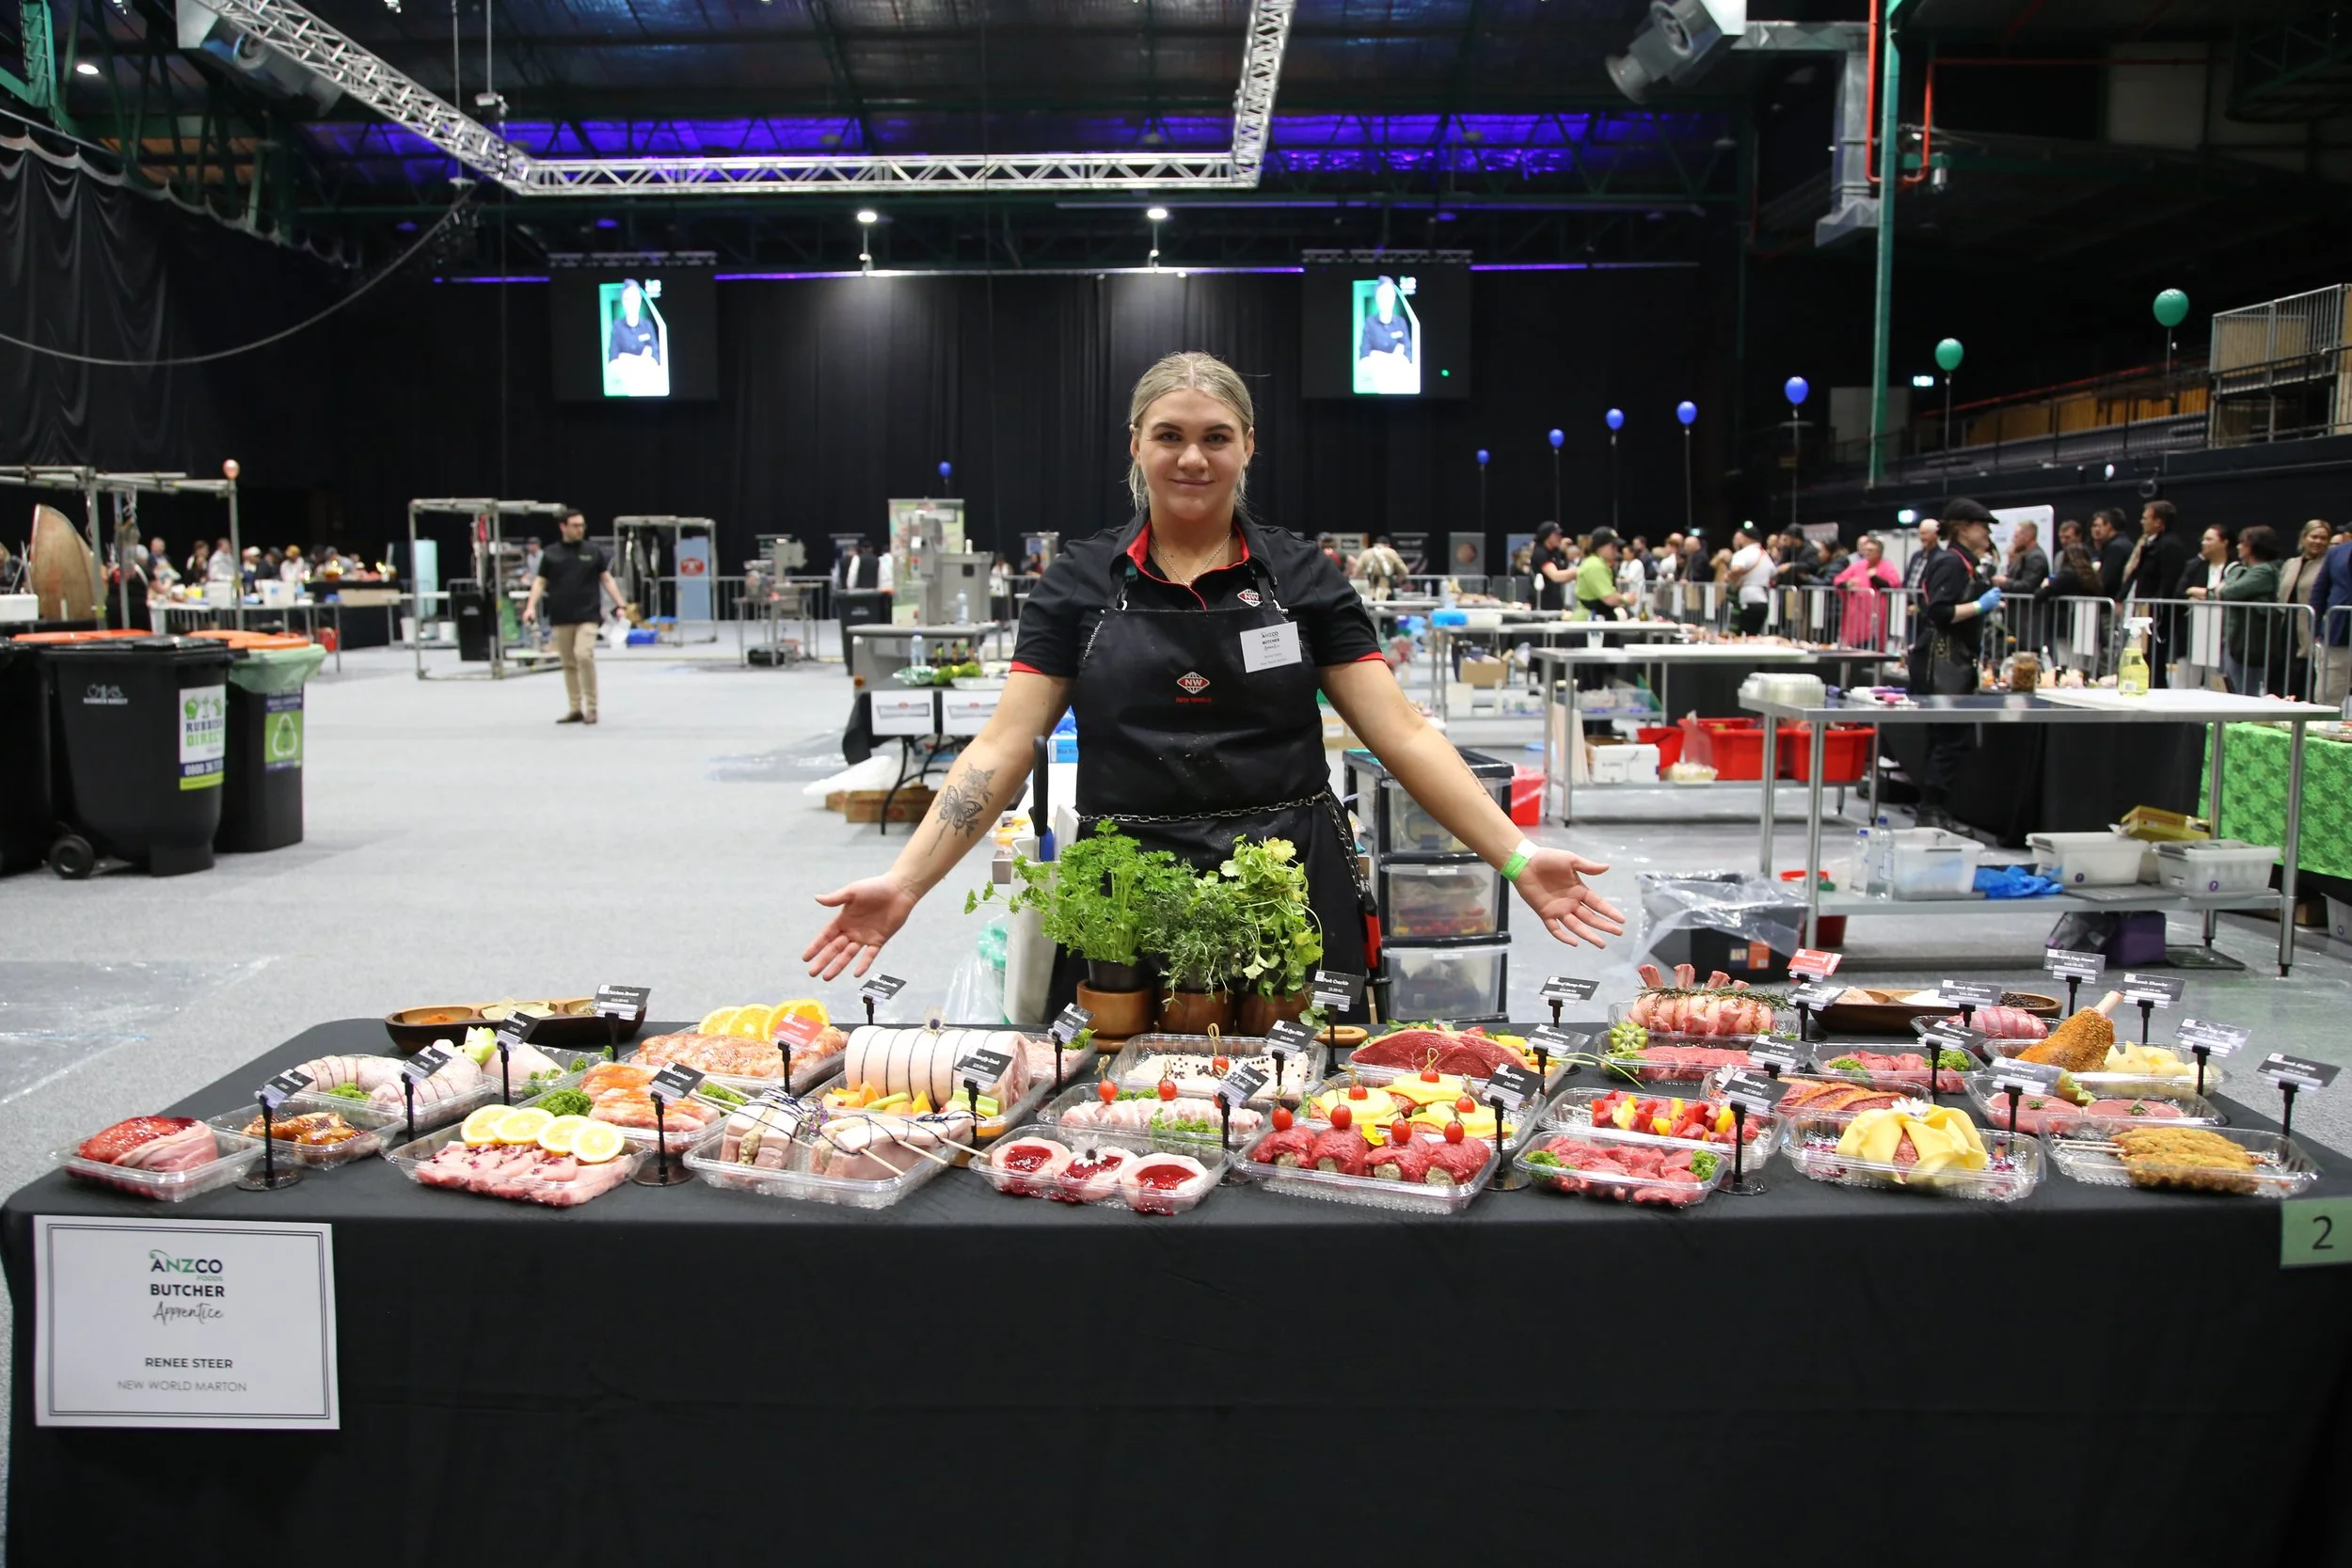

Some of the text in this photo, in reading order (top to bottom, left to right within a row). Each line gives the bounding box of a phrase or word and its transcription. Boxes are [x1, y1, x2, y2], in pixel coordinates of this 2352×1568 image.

[1184, 678, 1203, 687] NW
[2312, 1215, 2334, 1250] 2
[151, 1258, 223, 1274] ANZCO
[151, 1283, 225, 1297] BUTCHER
[151, 1301, 224, 1326] Apprentice
[144, 1357, 233, 1369] RENEE STEER
[117, 1380, 247, 1392] NEW WORLD MARTON
